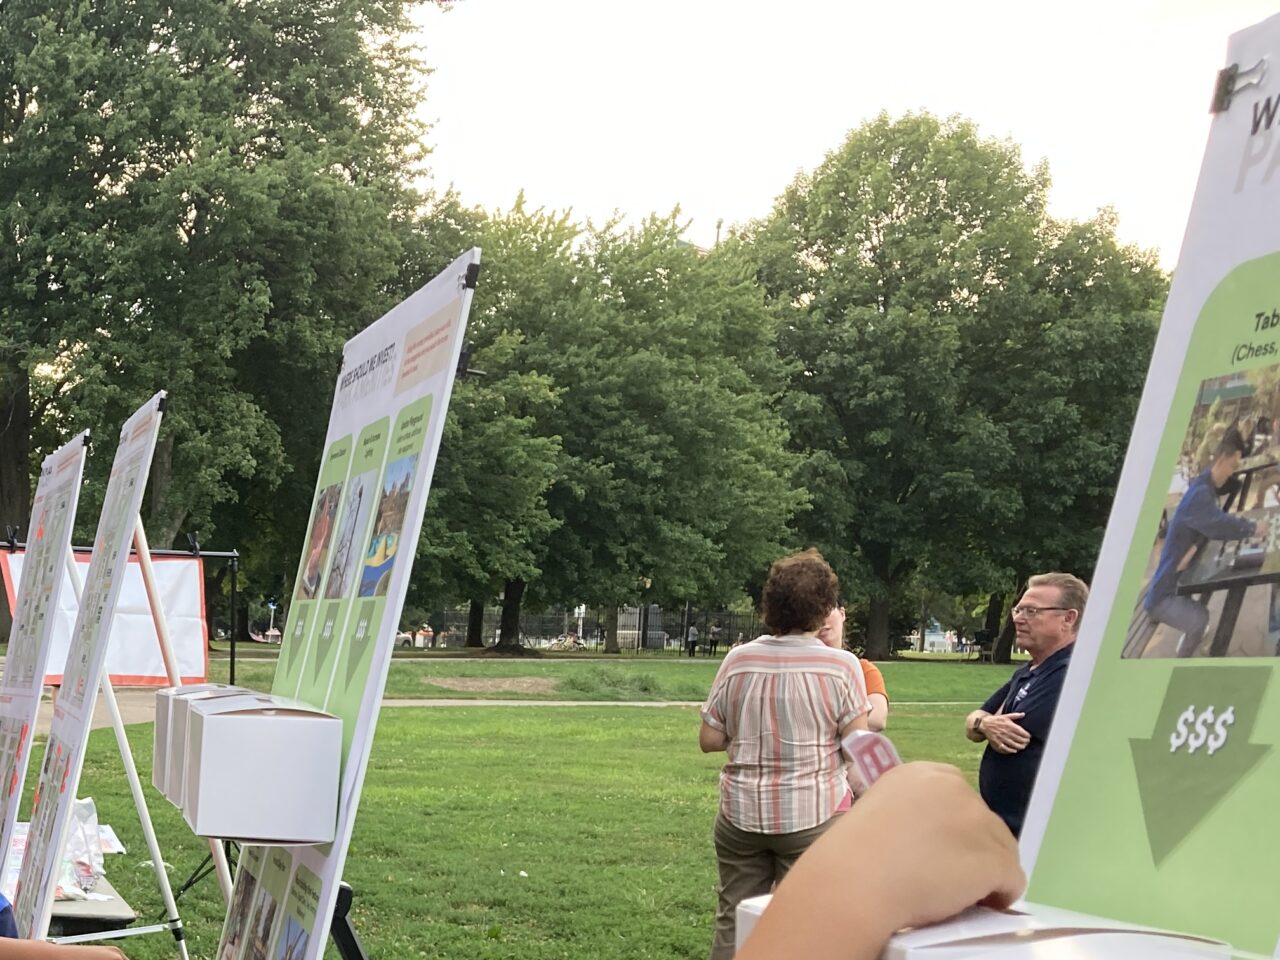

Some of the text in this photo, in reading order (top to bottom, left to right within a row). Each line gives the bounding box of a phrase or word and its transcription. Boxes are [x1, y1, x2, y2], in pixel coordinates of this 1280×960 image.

[1251, 94, 1280, 136] W
[1231, 341, 1278, 366] (Chess,
[1170, 704, 1235, 755] $$$
